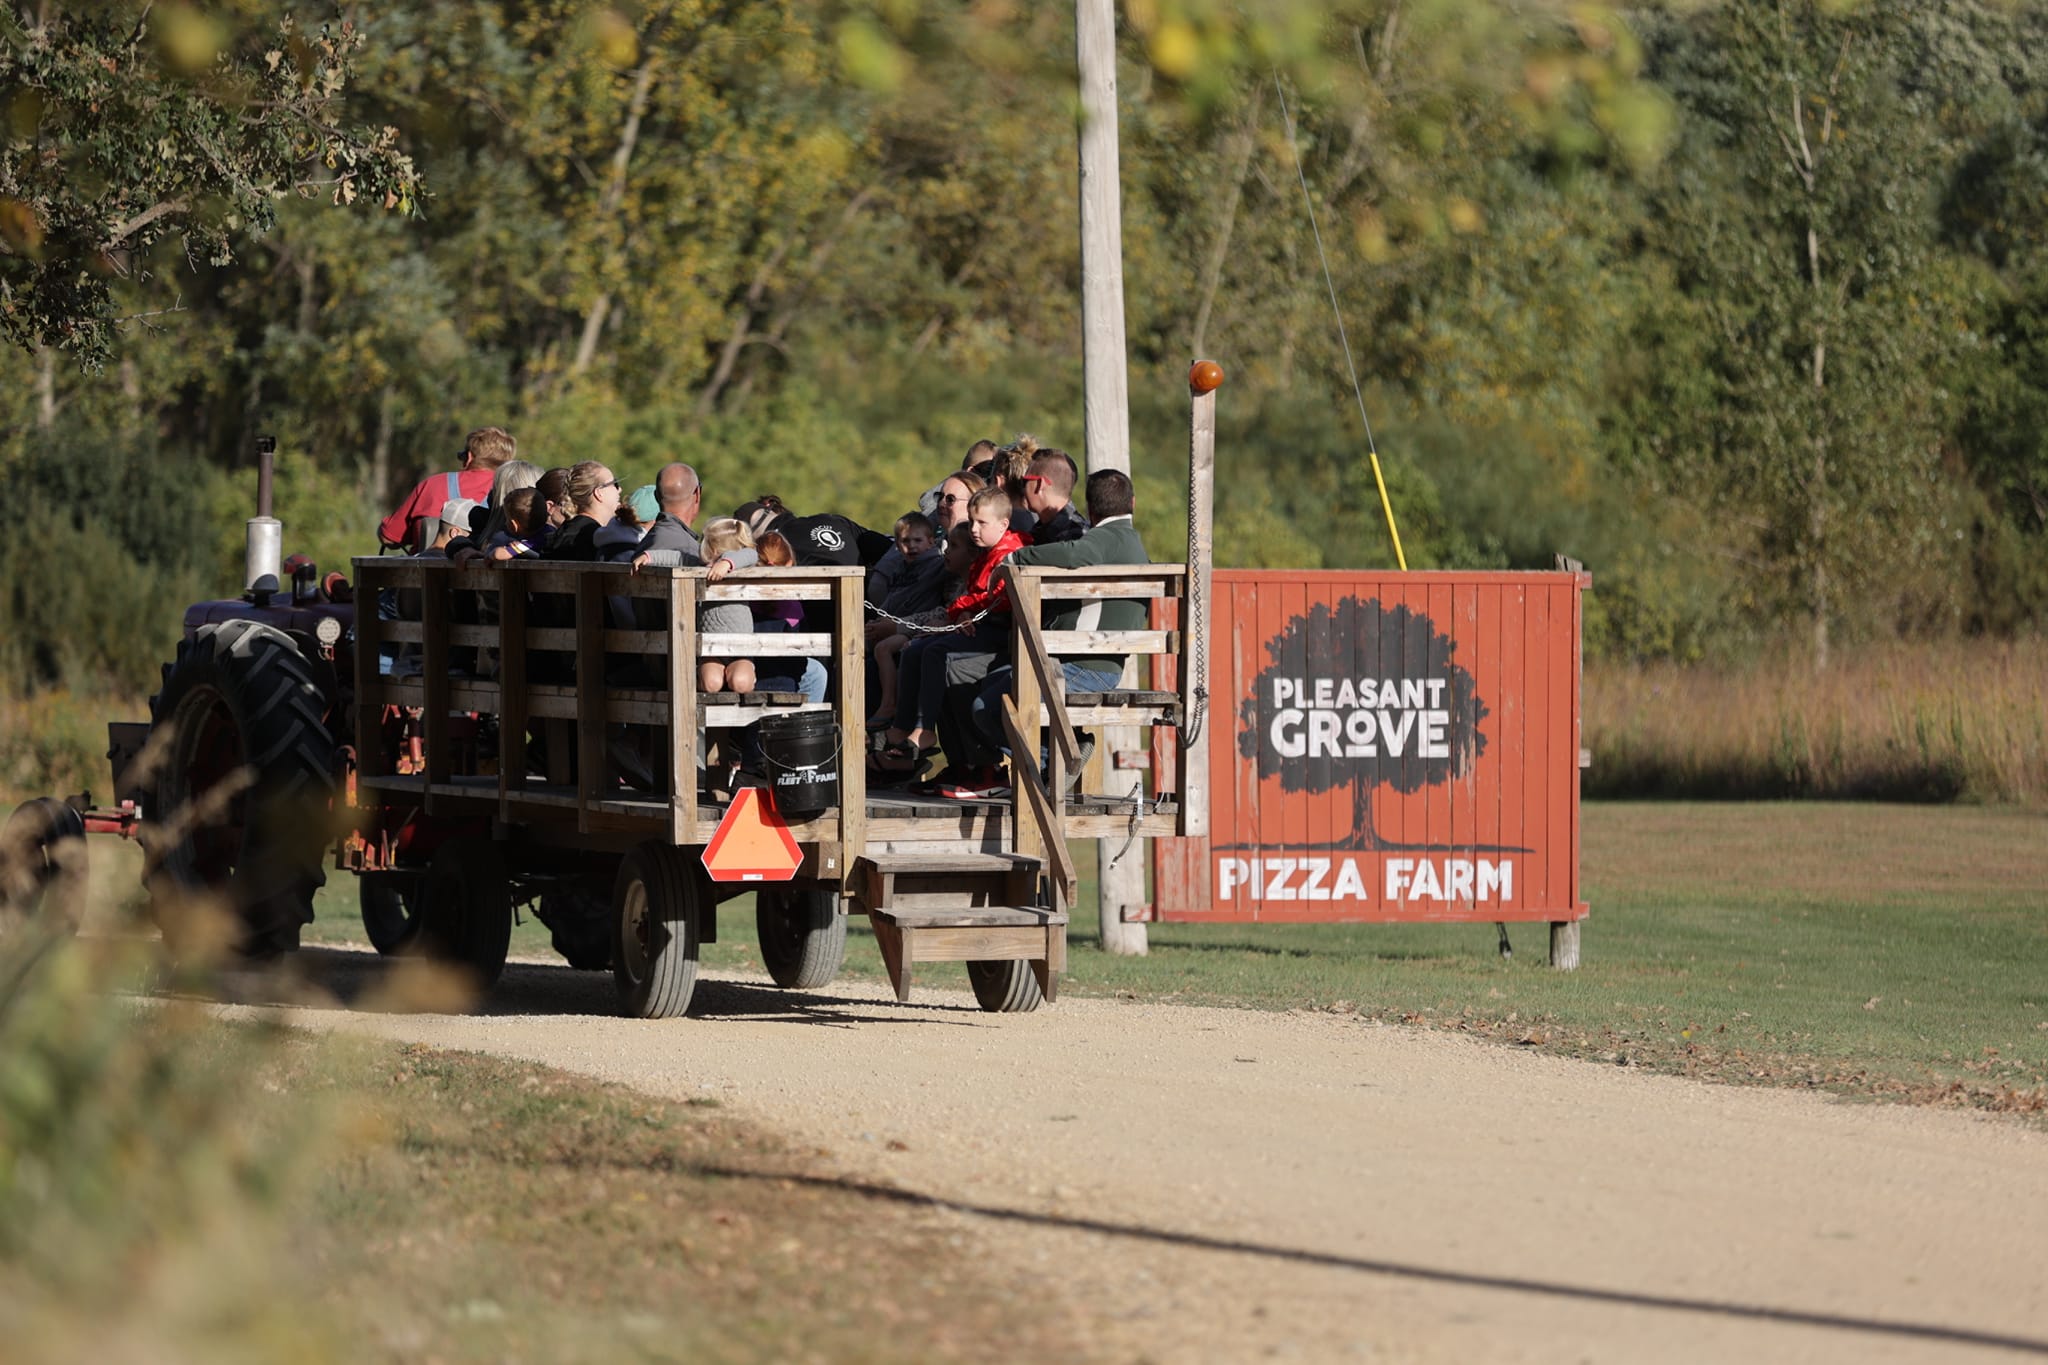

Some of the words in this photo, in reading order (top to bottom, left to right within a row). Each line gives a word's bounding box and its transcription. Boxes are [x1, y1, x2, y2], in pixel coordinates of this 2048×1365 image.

[1274, 678, 1446, 709] PLEASANT
[1270, 709, 1450, 758] GROVE
[1219, 857, 1368, 901] PIZZA
[1385, 858, 1513, 902] FARM
